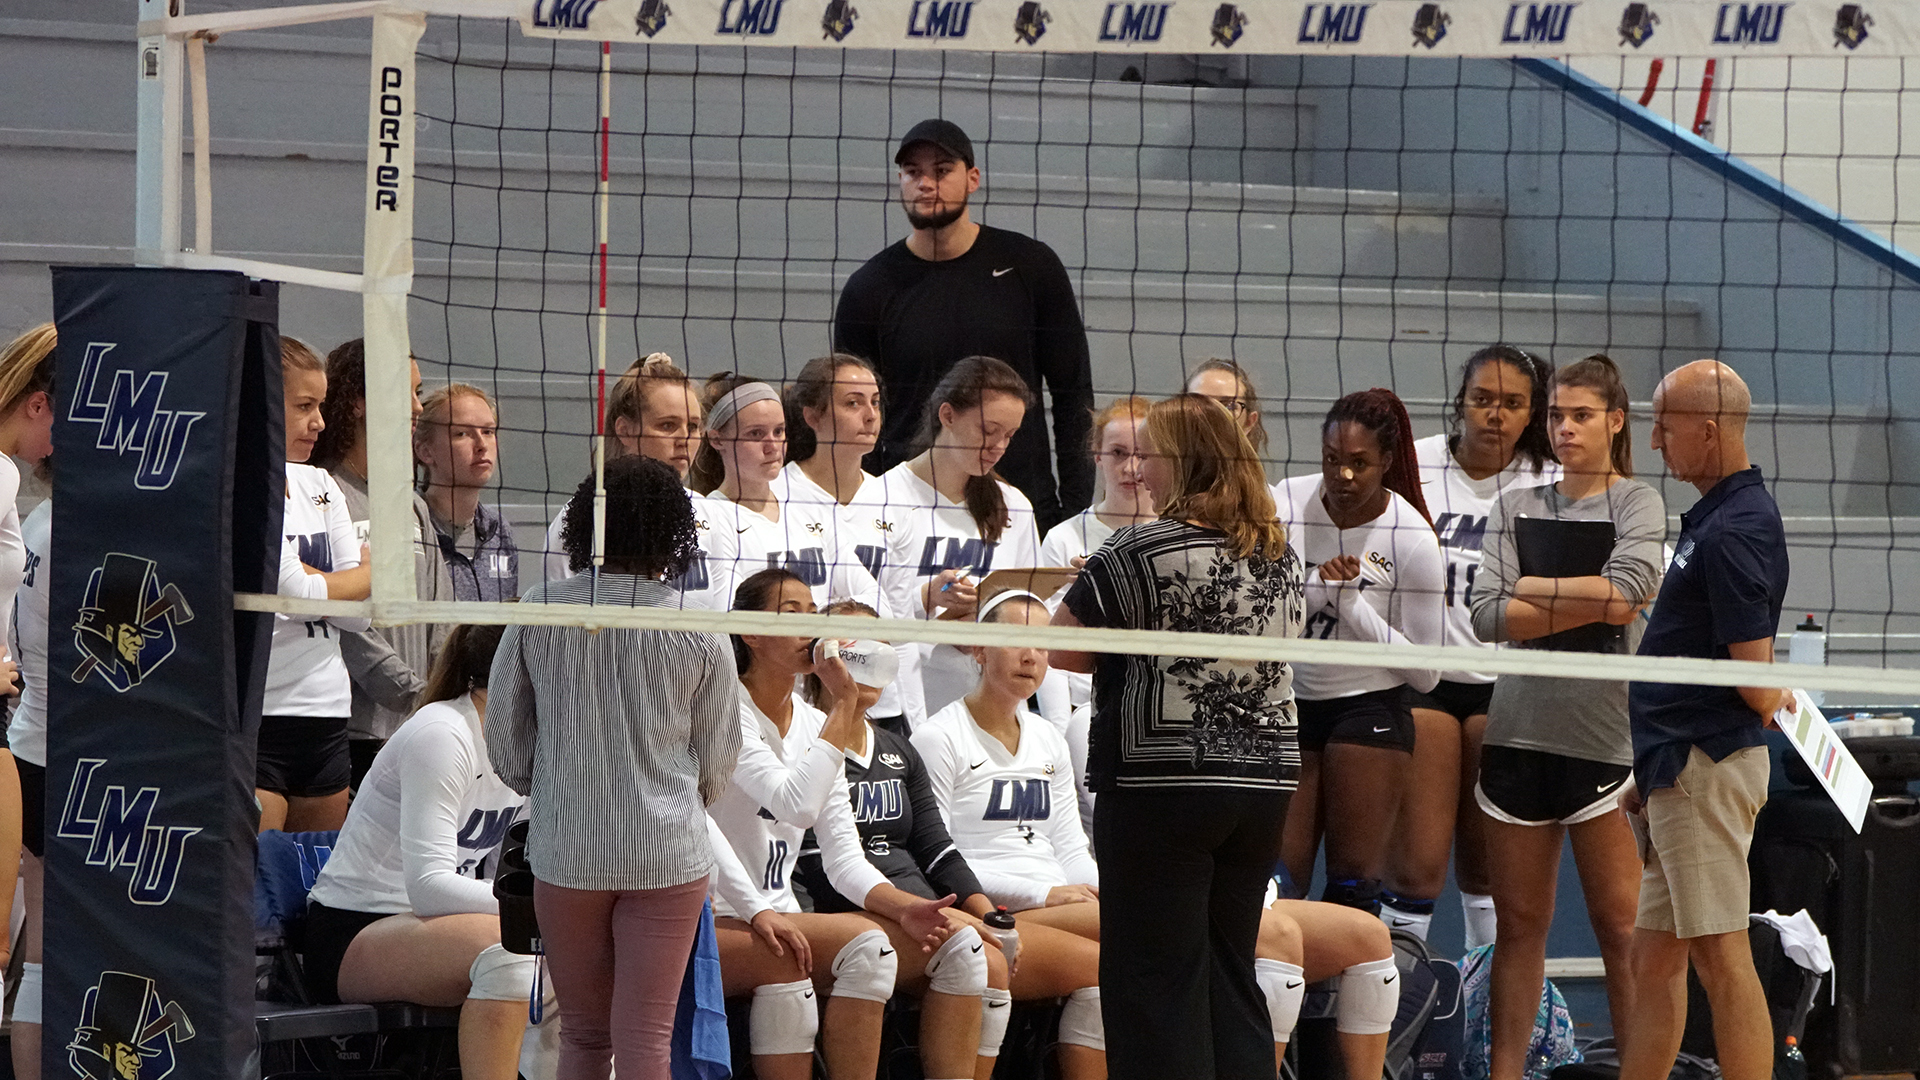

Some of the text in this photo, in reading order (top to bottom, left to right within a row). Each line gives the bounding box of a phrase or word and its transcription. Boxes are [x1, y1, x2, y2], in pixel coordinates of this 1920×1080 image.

[532, 0, 1795, 49] LMU LMU LMU LMU LMU LMU LMU
[375, 66, 403, 213] PORTER
[68, 342, 206, 490] LMU
[694, 520, 710, 531] AC
[1434, 512, 1488, 552] LM
[917, 536, 1001, 578] LMU
[1368, 551, 1394, 573] SAC
[982, 778, 1051, 822] LMU
[57, 758, 204, 906] LMU
[762, 839, 788, 891] 10
